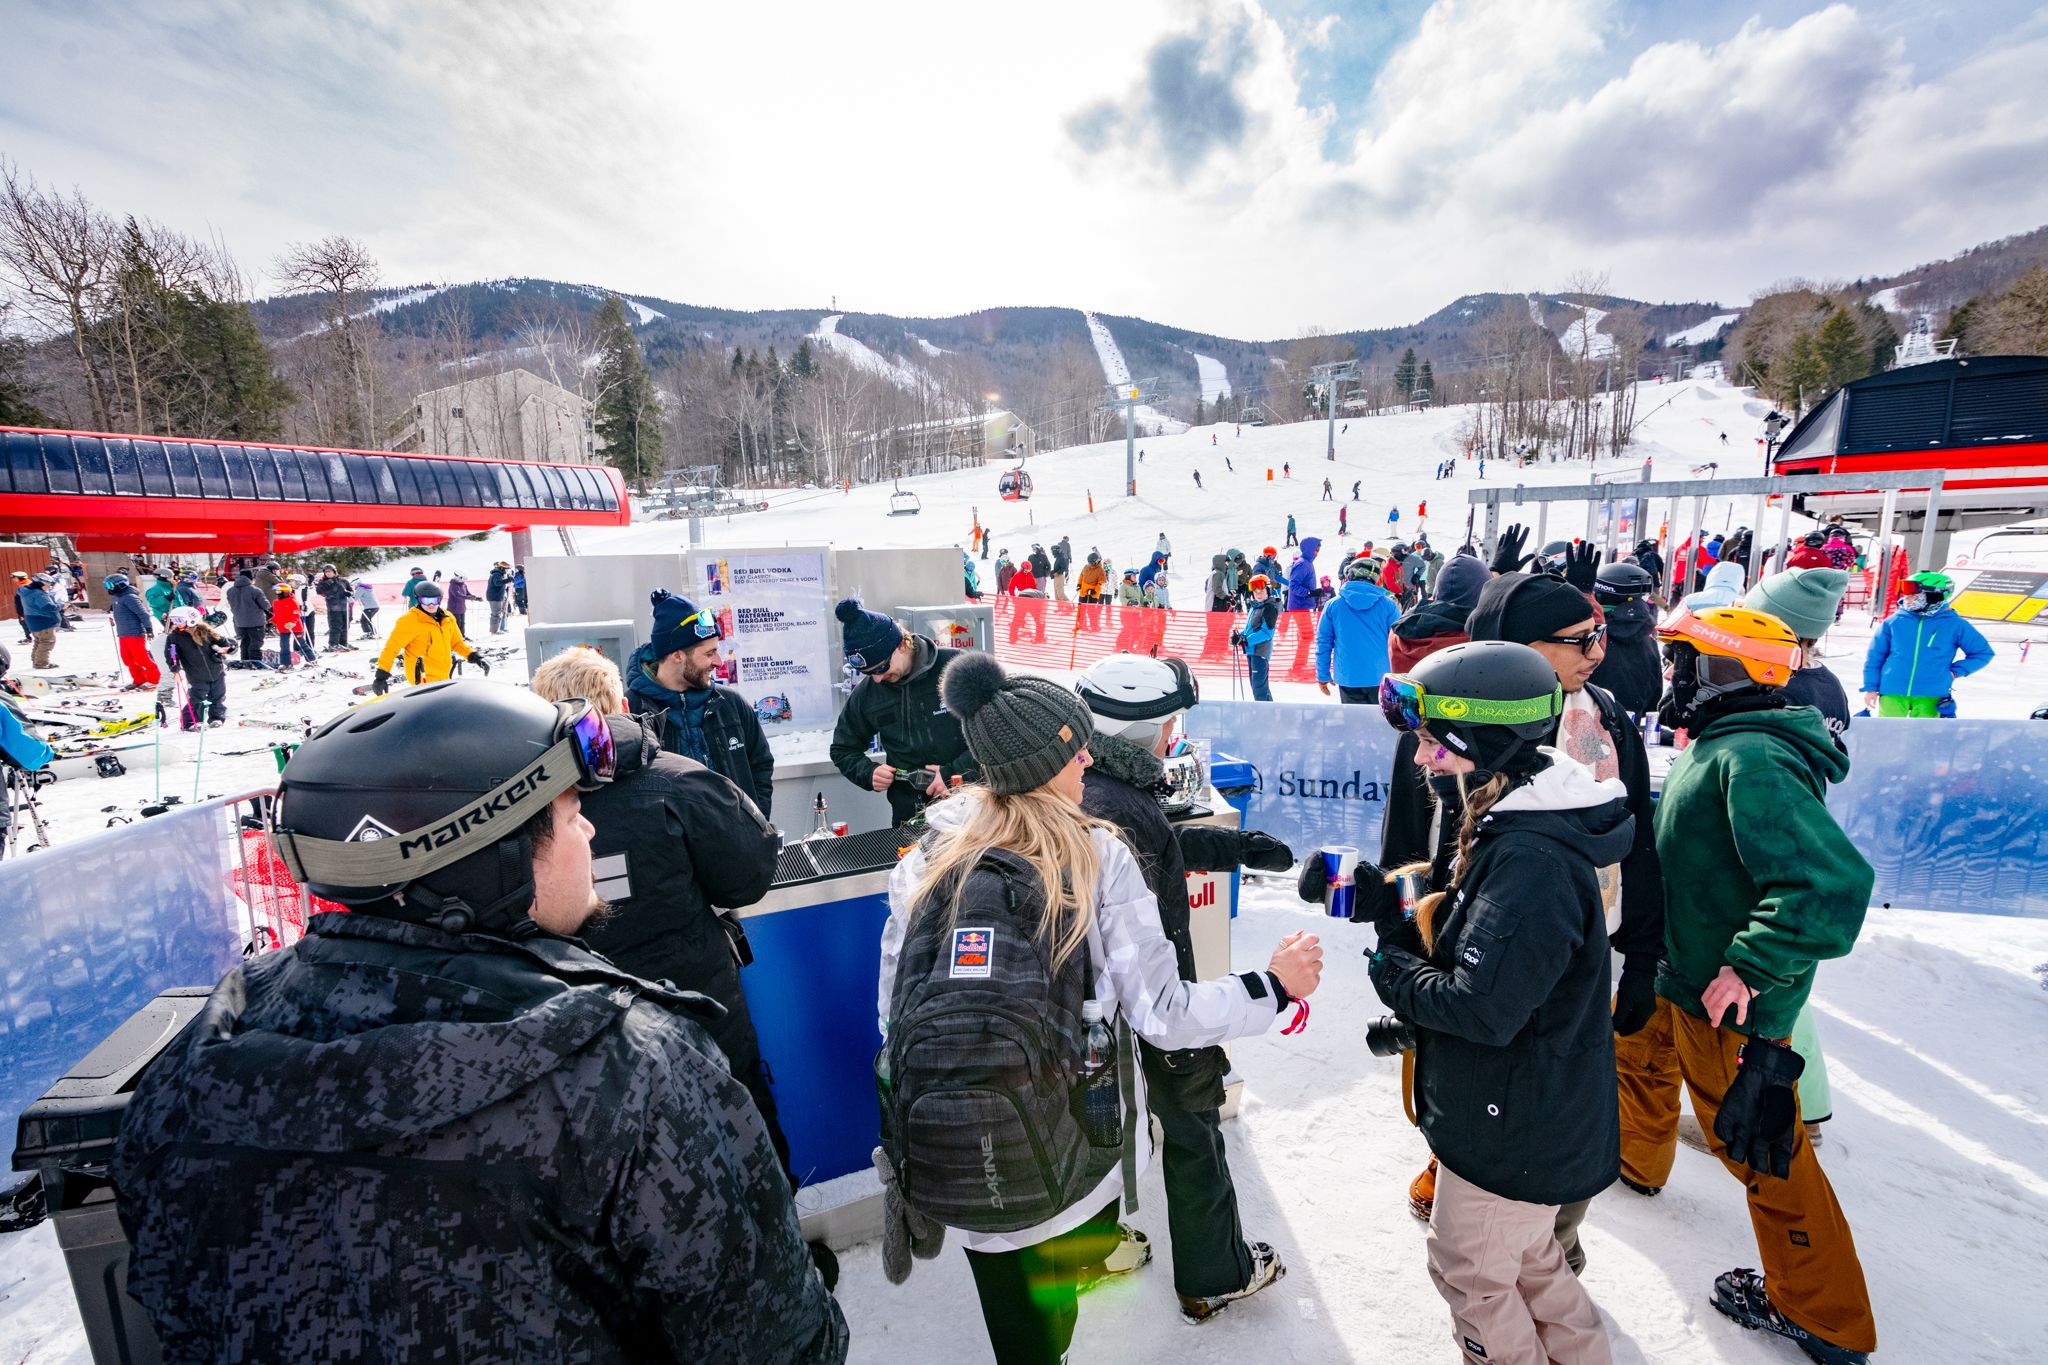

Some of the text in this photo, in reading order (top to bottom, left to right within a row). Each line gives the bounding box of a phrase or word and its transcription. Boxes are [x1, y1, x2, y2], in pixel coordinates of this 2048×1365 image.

[1690, 624, 1742, 648] SMITH
[1474, 706, 1538, 716] DRAGON
[400, 764, 552, 860] MARKER
[1190, 882, 1214, 908] ull
[957, 953, 986, 964] KTM
[1464, 952, 1480, 966] dope
[980, 1132, 1004, 1210] DAKINE
[1750, 1315, 1808, 1340] DALLLO
